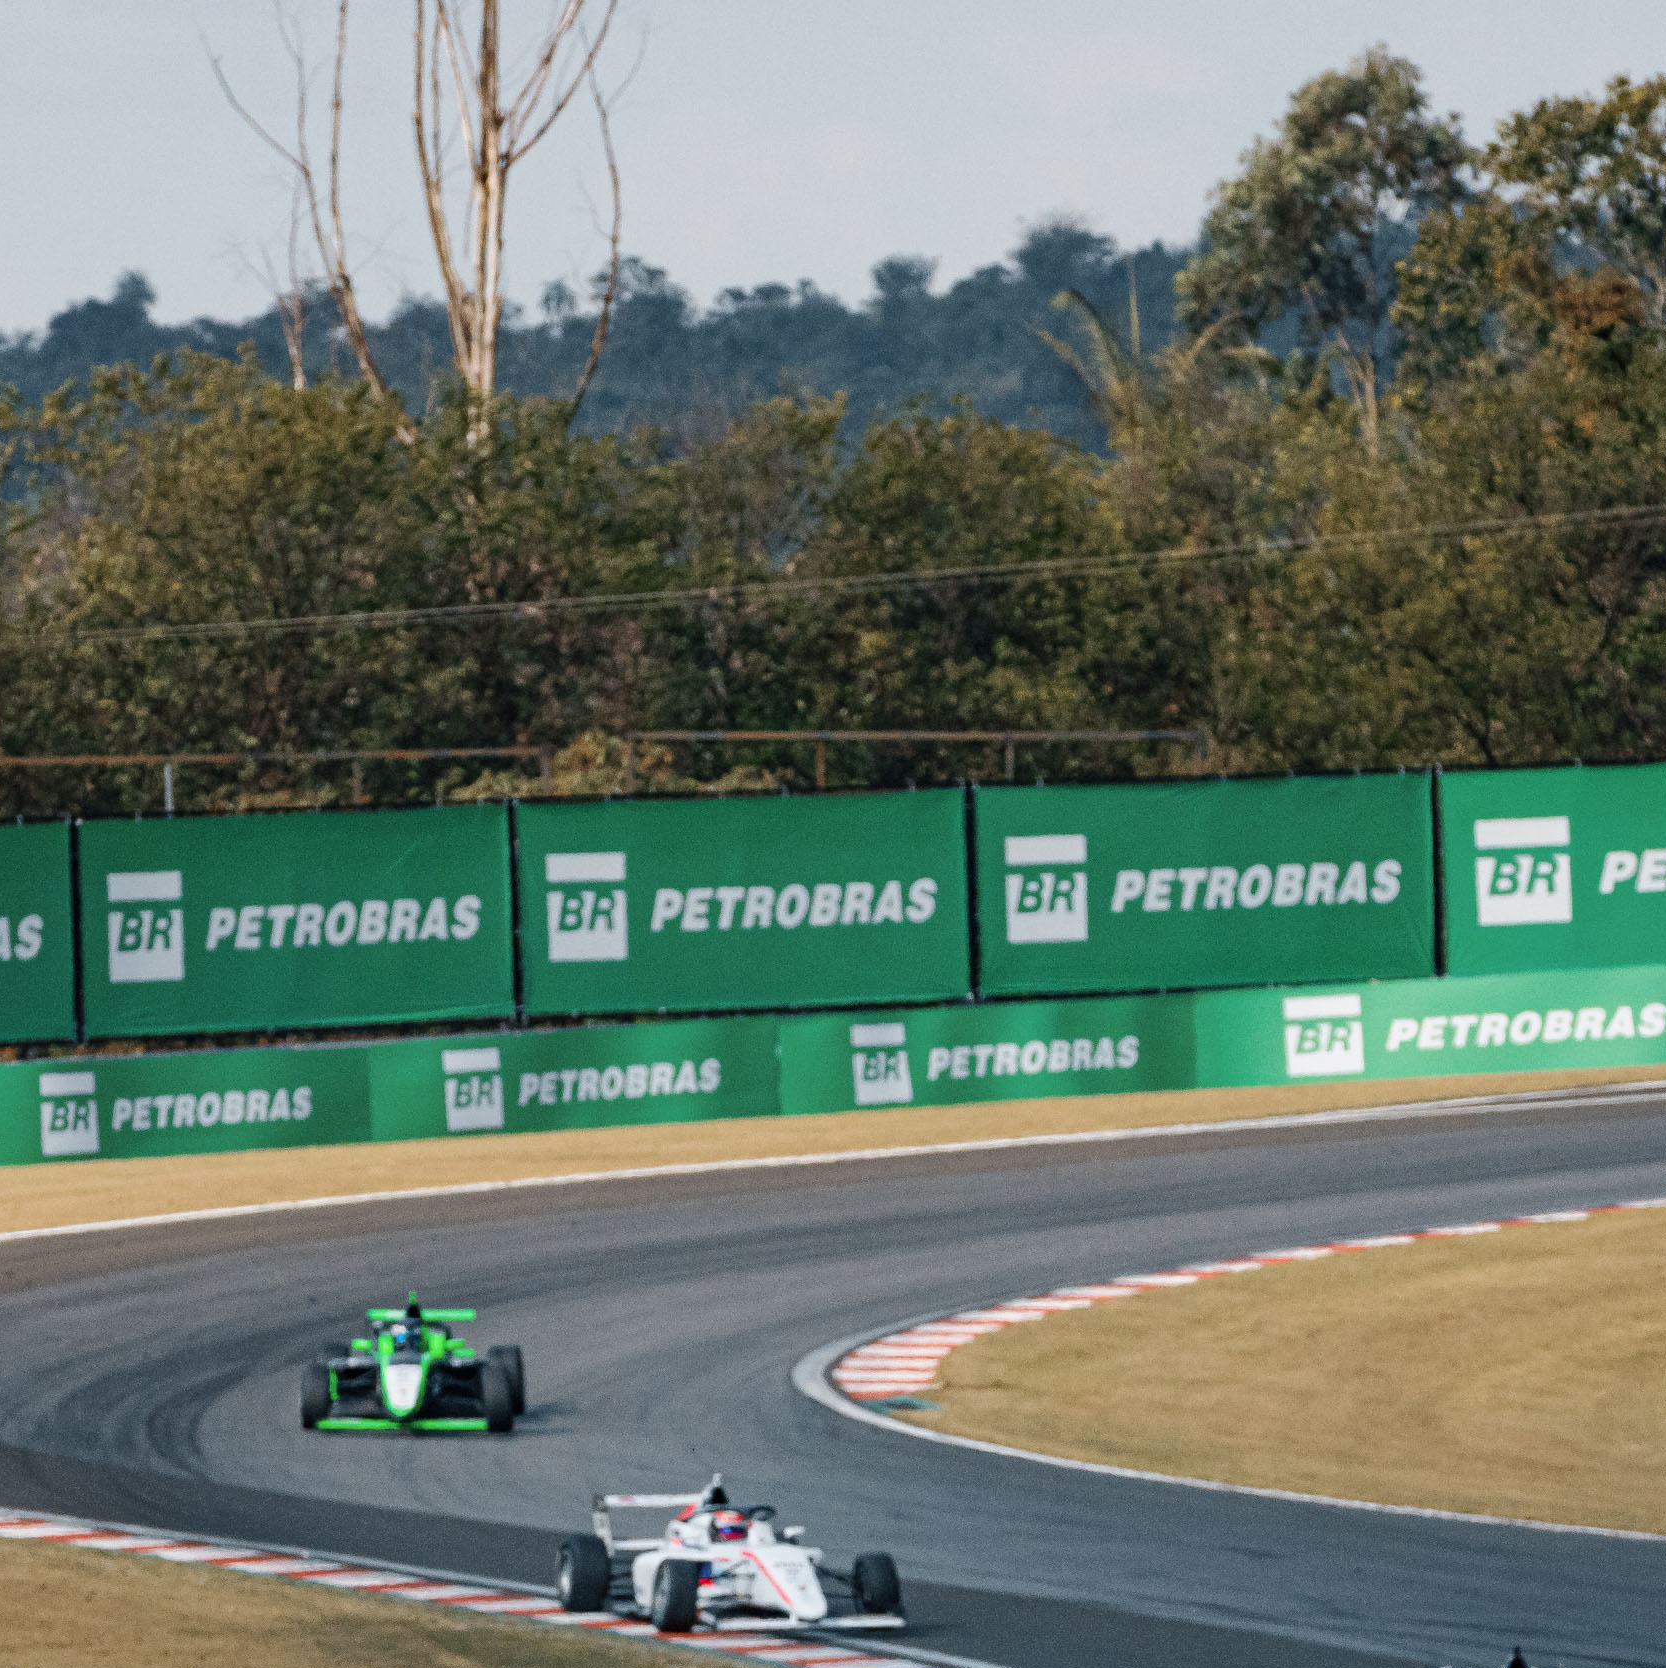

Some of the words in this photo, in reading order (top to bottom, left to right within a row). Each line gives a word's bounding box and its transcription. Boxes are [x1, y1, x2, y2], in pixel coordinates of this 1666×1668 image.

[1016, 872, 1074, 912] BR
[1111, 858, 1402, 913] PETROBRAS
[1488, 856, 1557, 897] BR
[116, 910, 171, 951] BR
[205, 894, 482, 951] PETROBRAS
[557, 890, 615, 931] BR
[650, 877, 938, 932] PETROBRAS
[862, 1051, 901, 1082] BR
[927, 1035, 1140, 1081] PETROBRAS
[1295, 1022, 1350, 1054] BR
[453, 1076, 494, 1107] BR
[518, 1057, 721, 1106] PETROBRAS
[47, 1101, 91, 1132] BR
[111, 1086, 312, 1131] PETROBRAS
